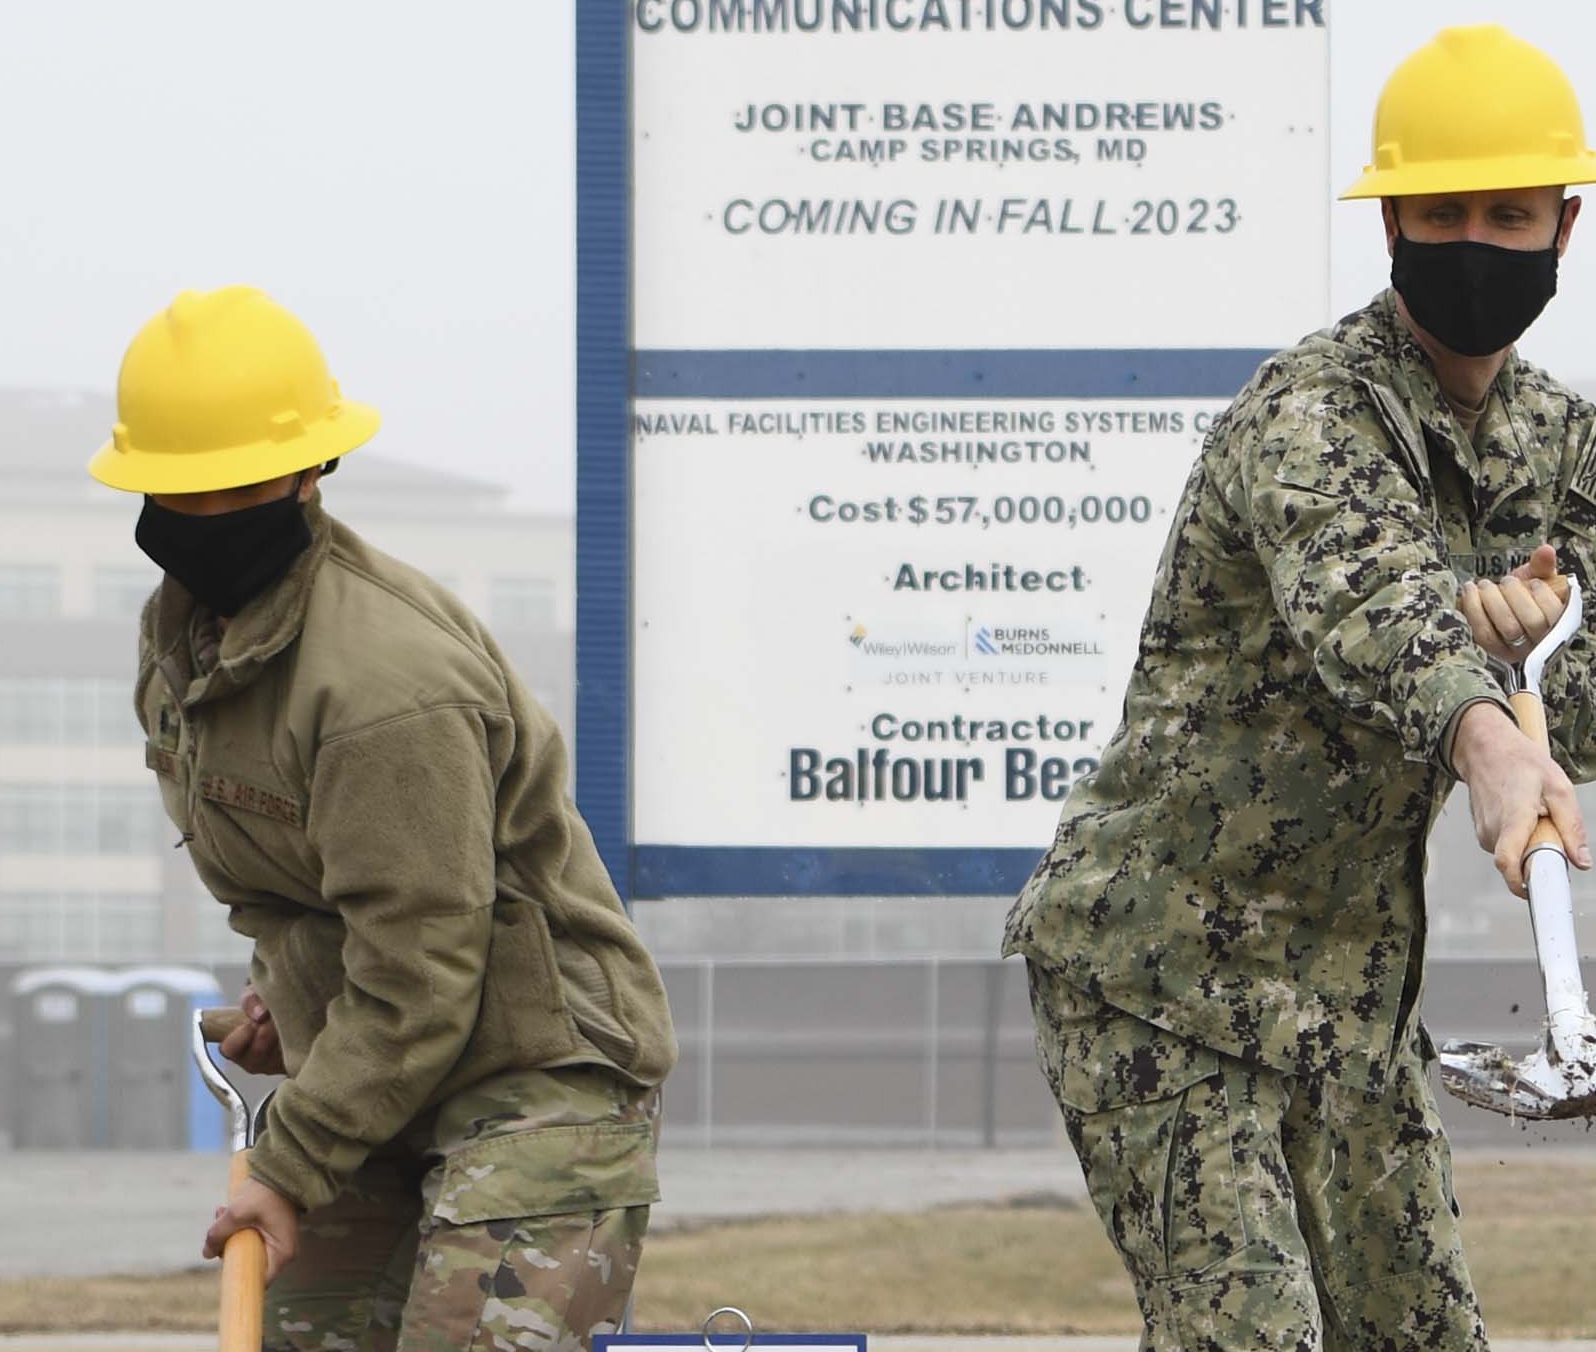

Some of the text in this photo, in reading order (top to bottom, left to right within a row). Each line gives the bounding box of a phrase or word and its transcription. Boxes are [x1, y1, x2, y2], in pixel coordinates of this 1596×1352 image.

[735, 101, 1224, 132] JOINT BASE ANDREWS
[810, 138, 1148, 165] CAMP SPRINGS, MD
[722, 198, 1239, 236] COMING IN FALL 2023
[635, 413, 719, 436] NAVAL
[728, 412, 867, 434] FACILITIES
[876, 411, 1056, 433] ENGINEERING
[1063, 411, 1185, 434] SYSTEMS
[866, 441, 1092, 464] WASHINGTON
[808, 494, 1152, 528] Cost $57,000,000
[893, 563, 1086, 592] Architect
[993, 628, 1051, 642] BURNS
[883, 670, 1050, 686] JOINT VENTURE
[870, 712, 1094, 743] Contractor
[789, 747, 985, 802] Balfour
